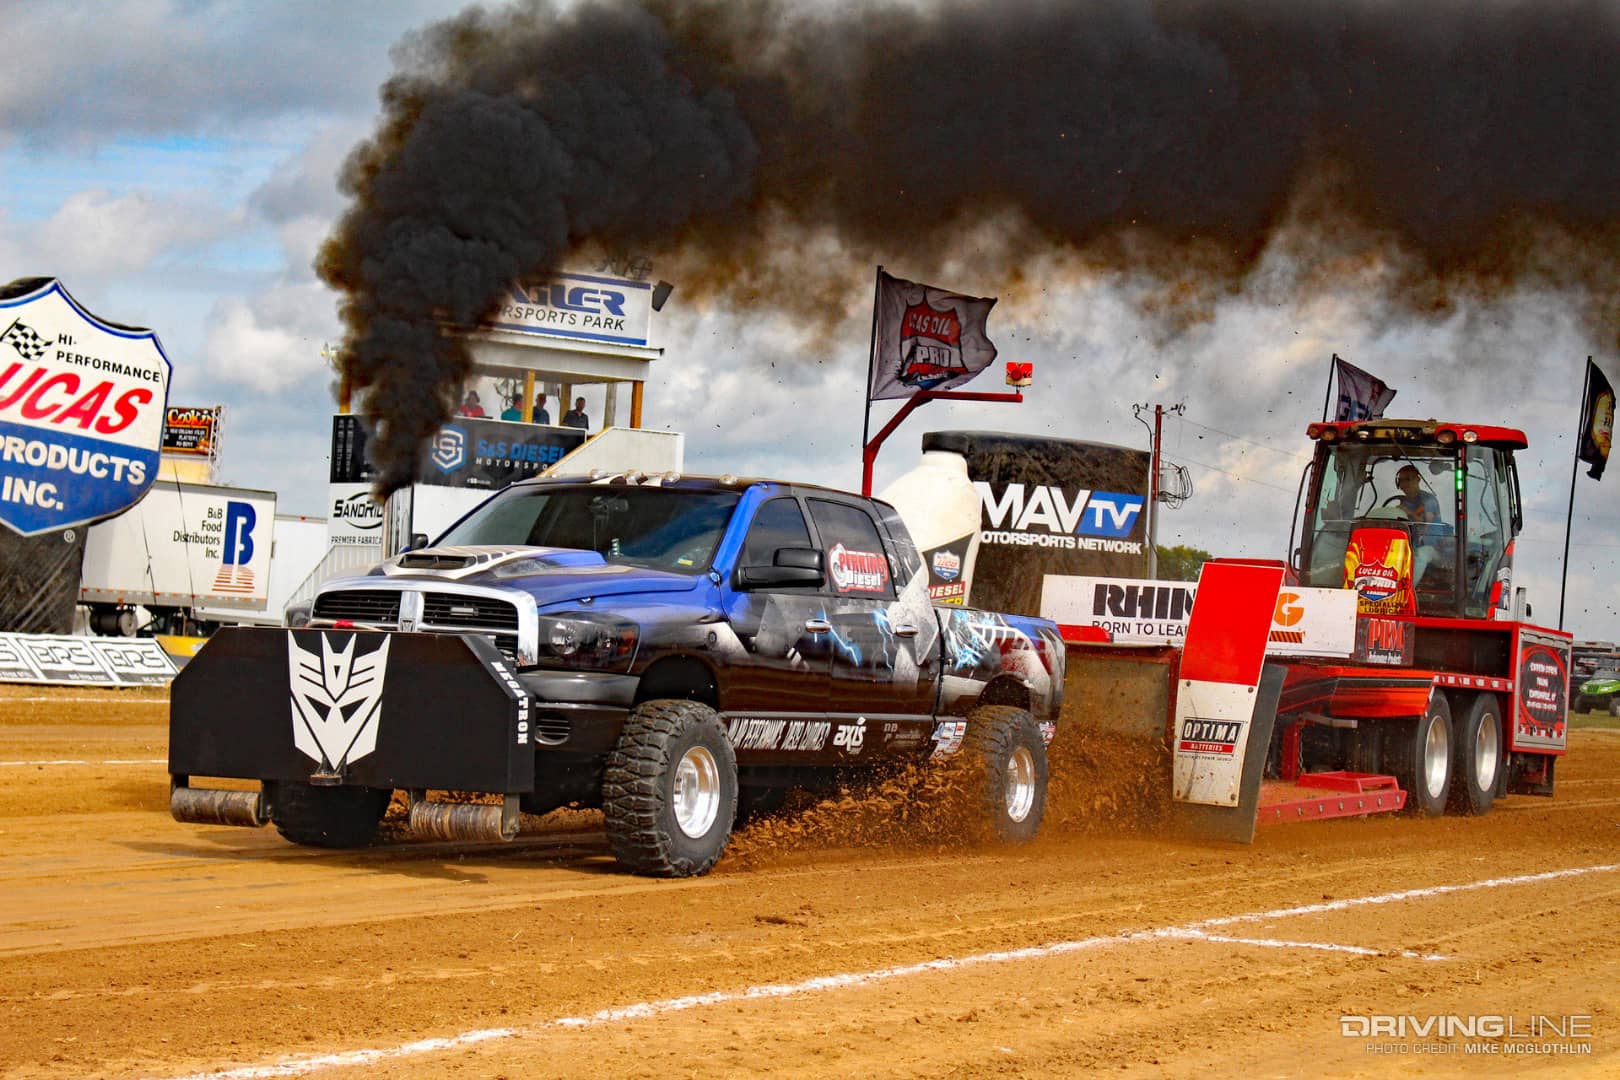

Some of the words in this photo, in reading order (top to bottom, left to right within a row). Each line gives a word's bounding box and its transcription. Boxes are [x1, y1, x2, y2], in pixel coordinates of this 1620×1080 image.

[583, 315, 625, 331] PARK
[58, 333, 77, 346] HI-
[56, 351, 161, 383] PERFORMANCE
[2, 476, 64, 511] INC.
[207, 507, 223, 519] B&B
[201, 520, 222, 532] Food
[173, 530, 221, 545] Distributors
[331, 536, 356, 545] PREMIER
[981, 531, 1076, 549] OTORSPORTS
[1078, 537, 1142, 555] NETWORK
[205, 547, 219, 559] Inc.
[1358, 567, 1381, 576] LUCAS
[1382, 569, 1394, 577] OIL
[928, 583, 964, 598] IESEL
[1136, 622, 1154, 636] TO
[1159, 623, 1187, 637] LEA
[491, 661, 529, 745] MEGATRON
[1183, 721, 1238, 742] OPTIMA
[1190, 743, 1223, 752] BATTERIES
